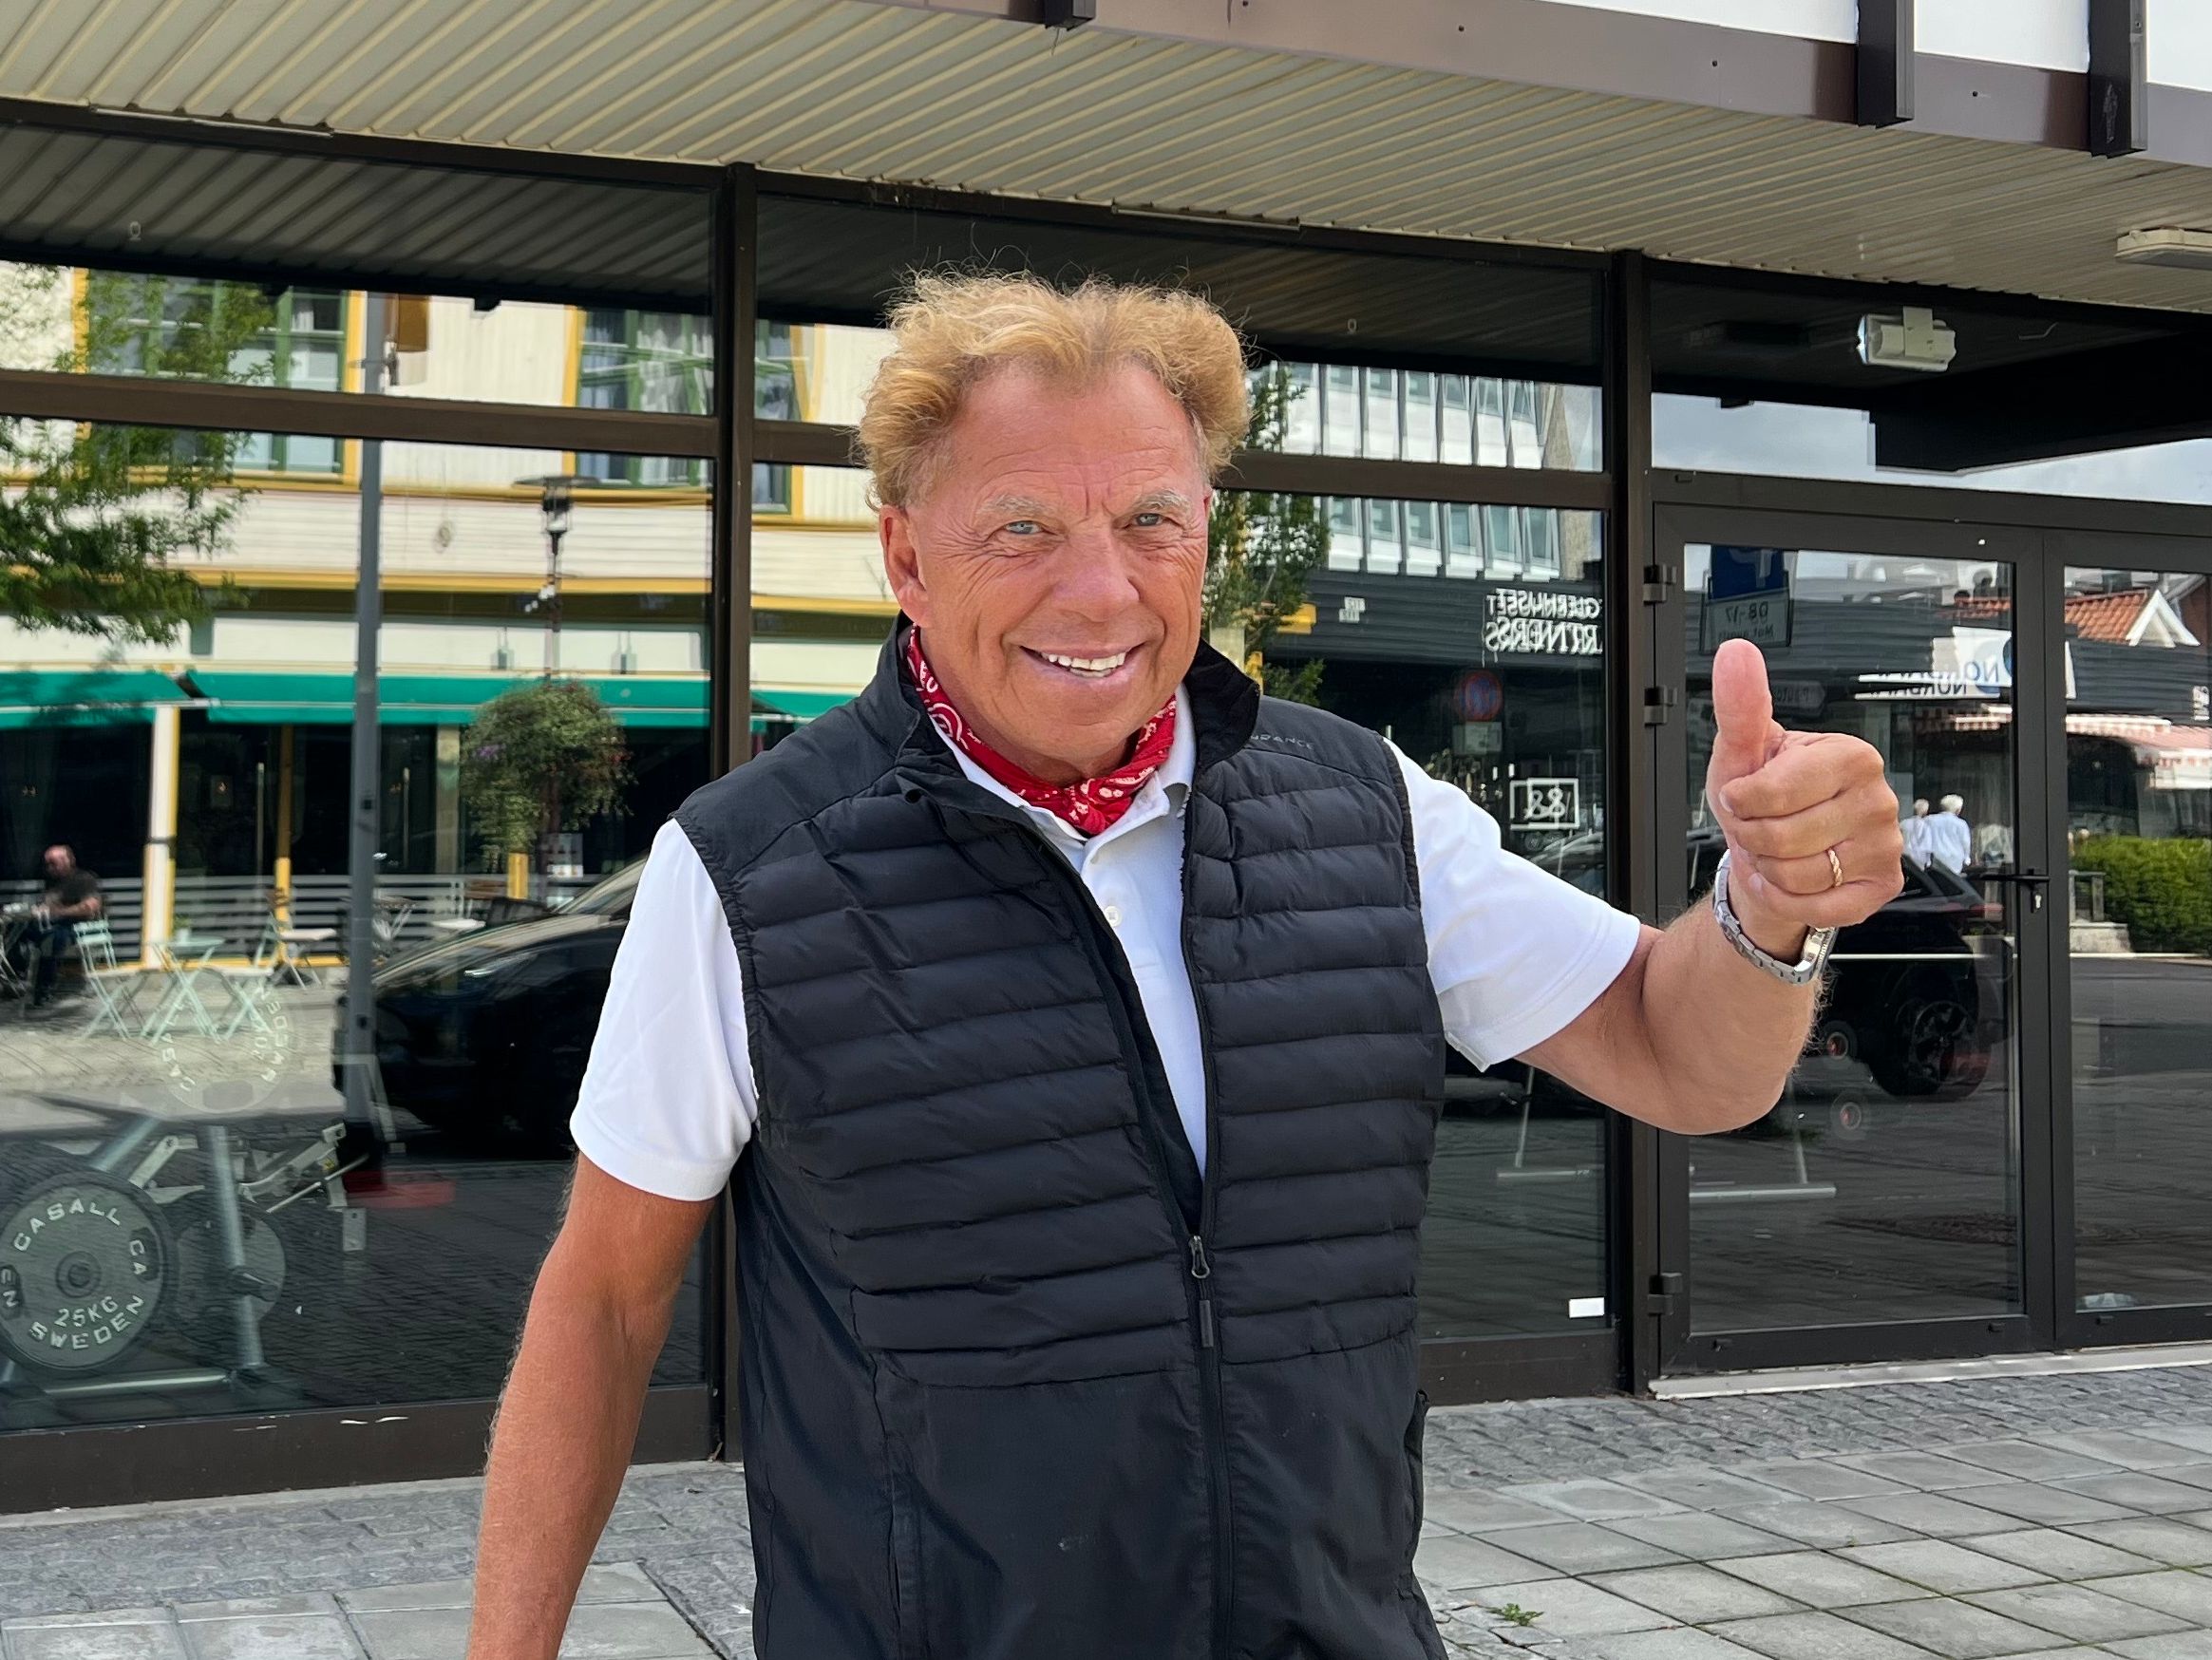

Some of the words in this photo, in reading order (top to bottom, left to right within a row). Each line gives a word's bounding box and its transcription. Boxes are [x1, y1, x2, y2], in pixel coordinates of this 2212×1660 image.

[12, 1198, 122, 1252] CASALL
[29, 1295, 144, 1349] SWEDEN
[54, 1295, 119, 1328] 25KG
